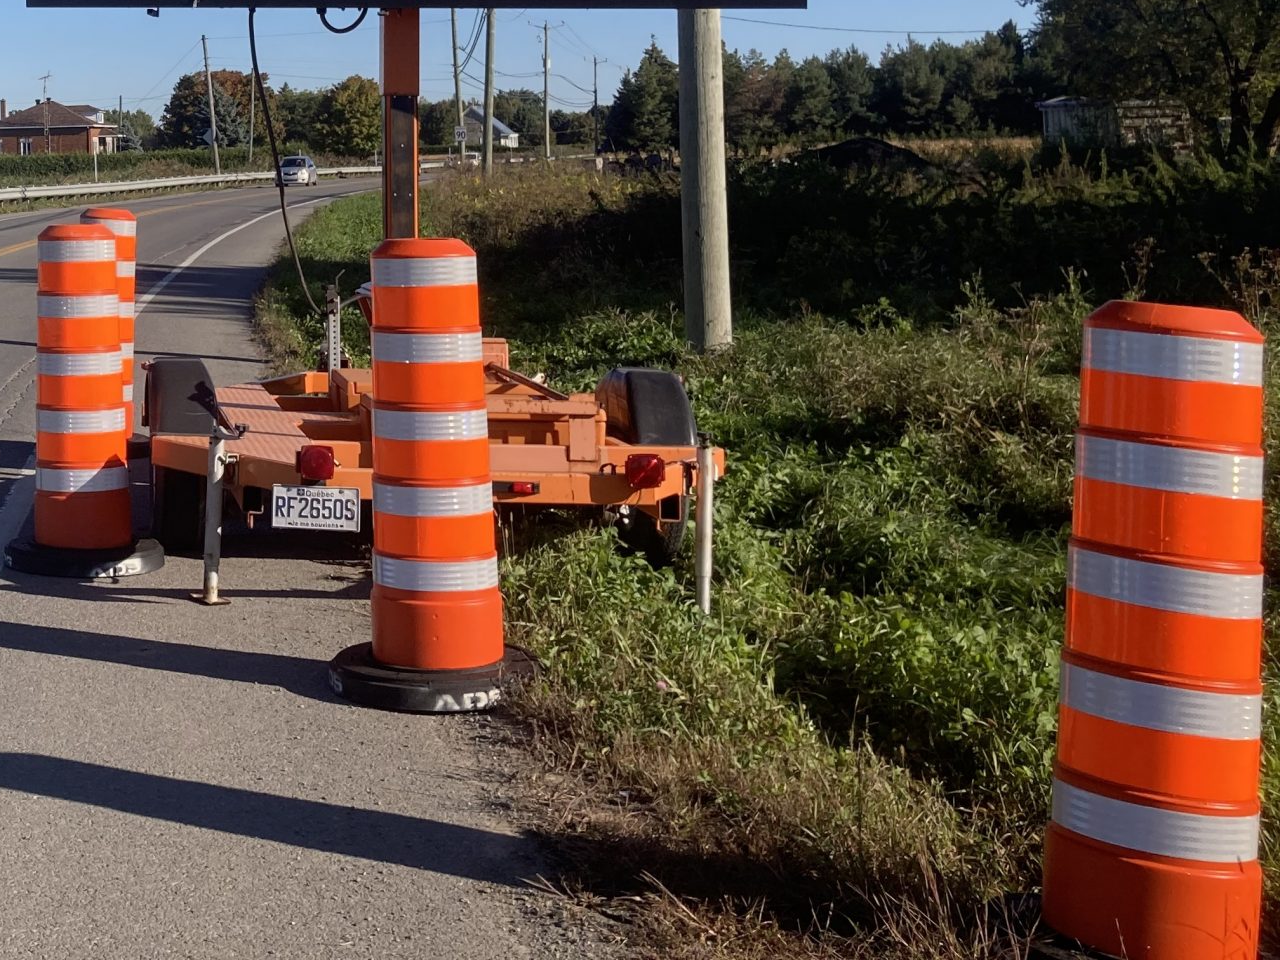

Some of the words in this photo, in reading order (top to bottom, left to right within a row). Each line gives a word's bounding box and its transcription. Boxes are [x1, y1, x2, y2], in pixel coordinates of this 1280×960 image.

[456, 131, 466, 139] 90
[305, 489, 335, 498] Québec
[275, 495, 356, 521] RF2650S
